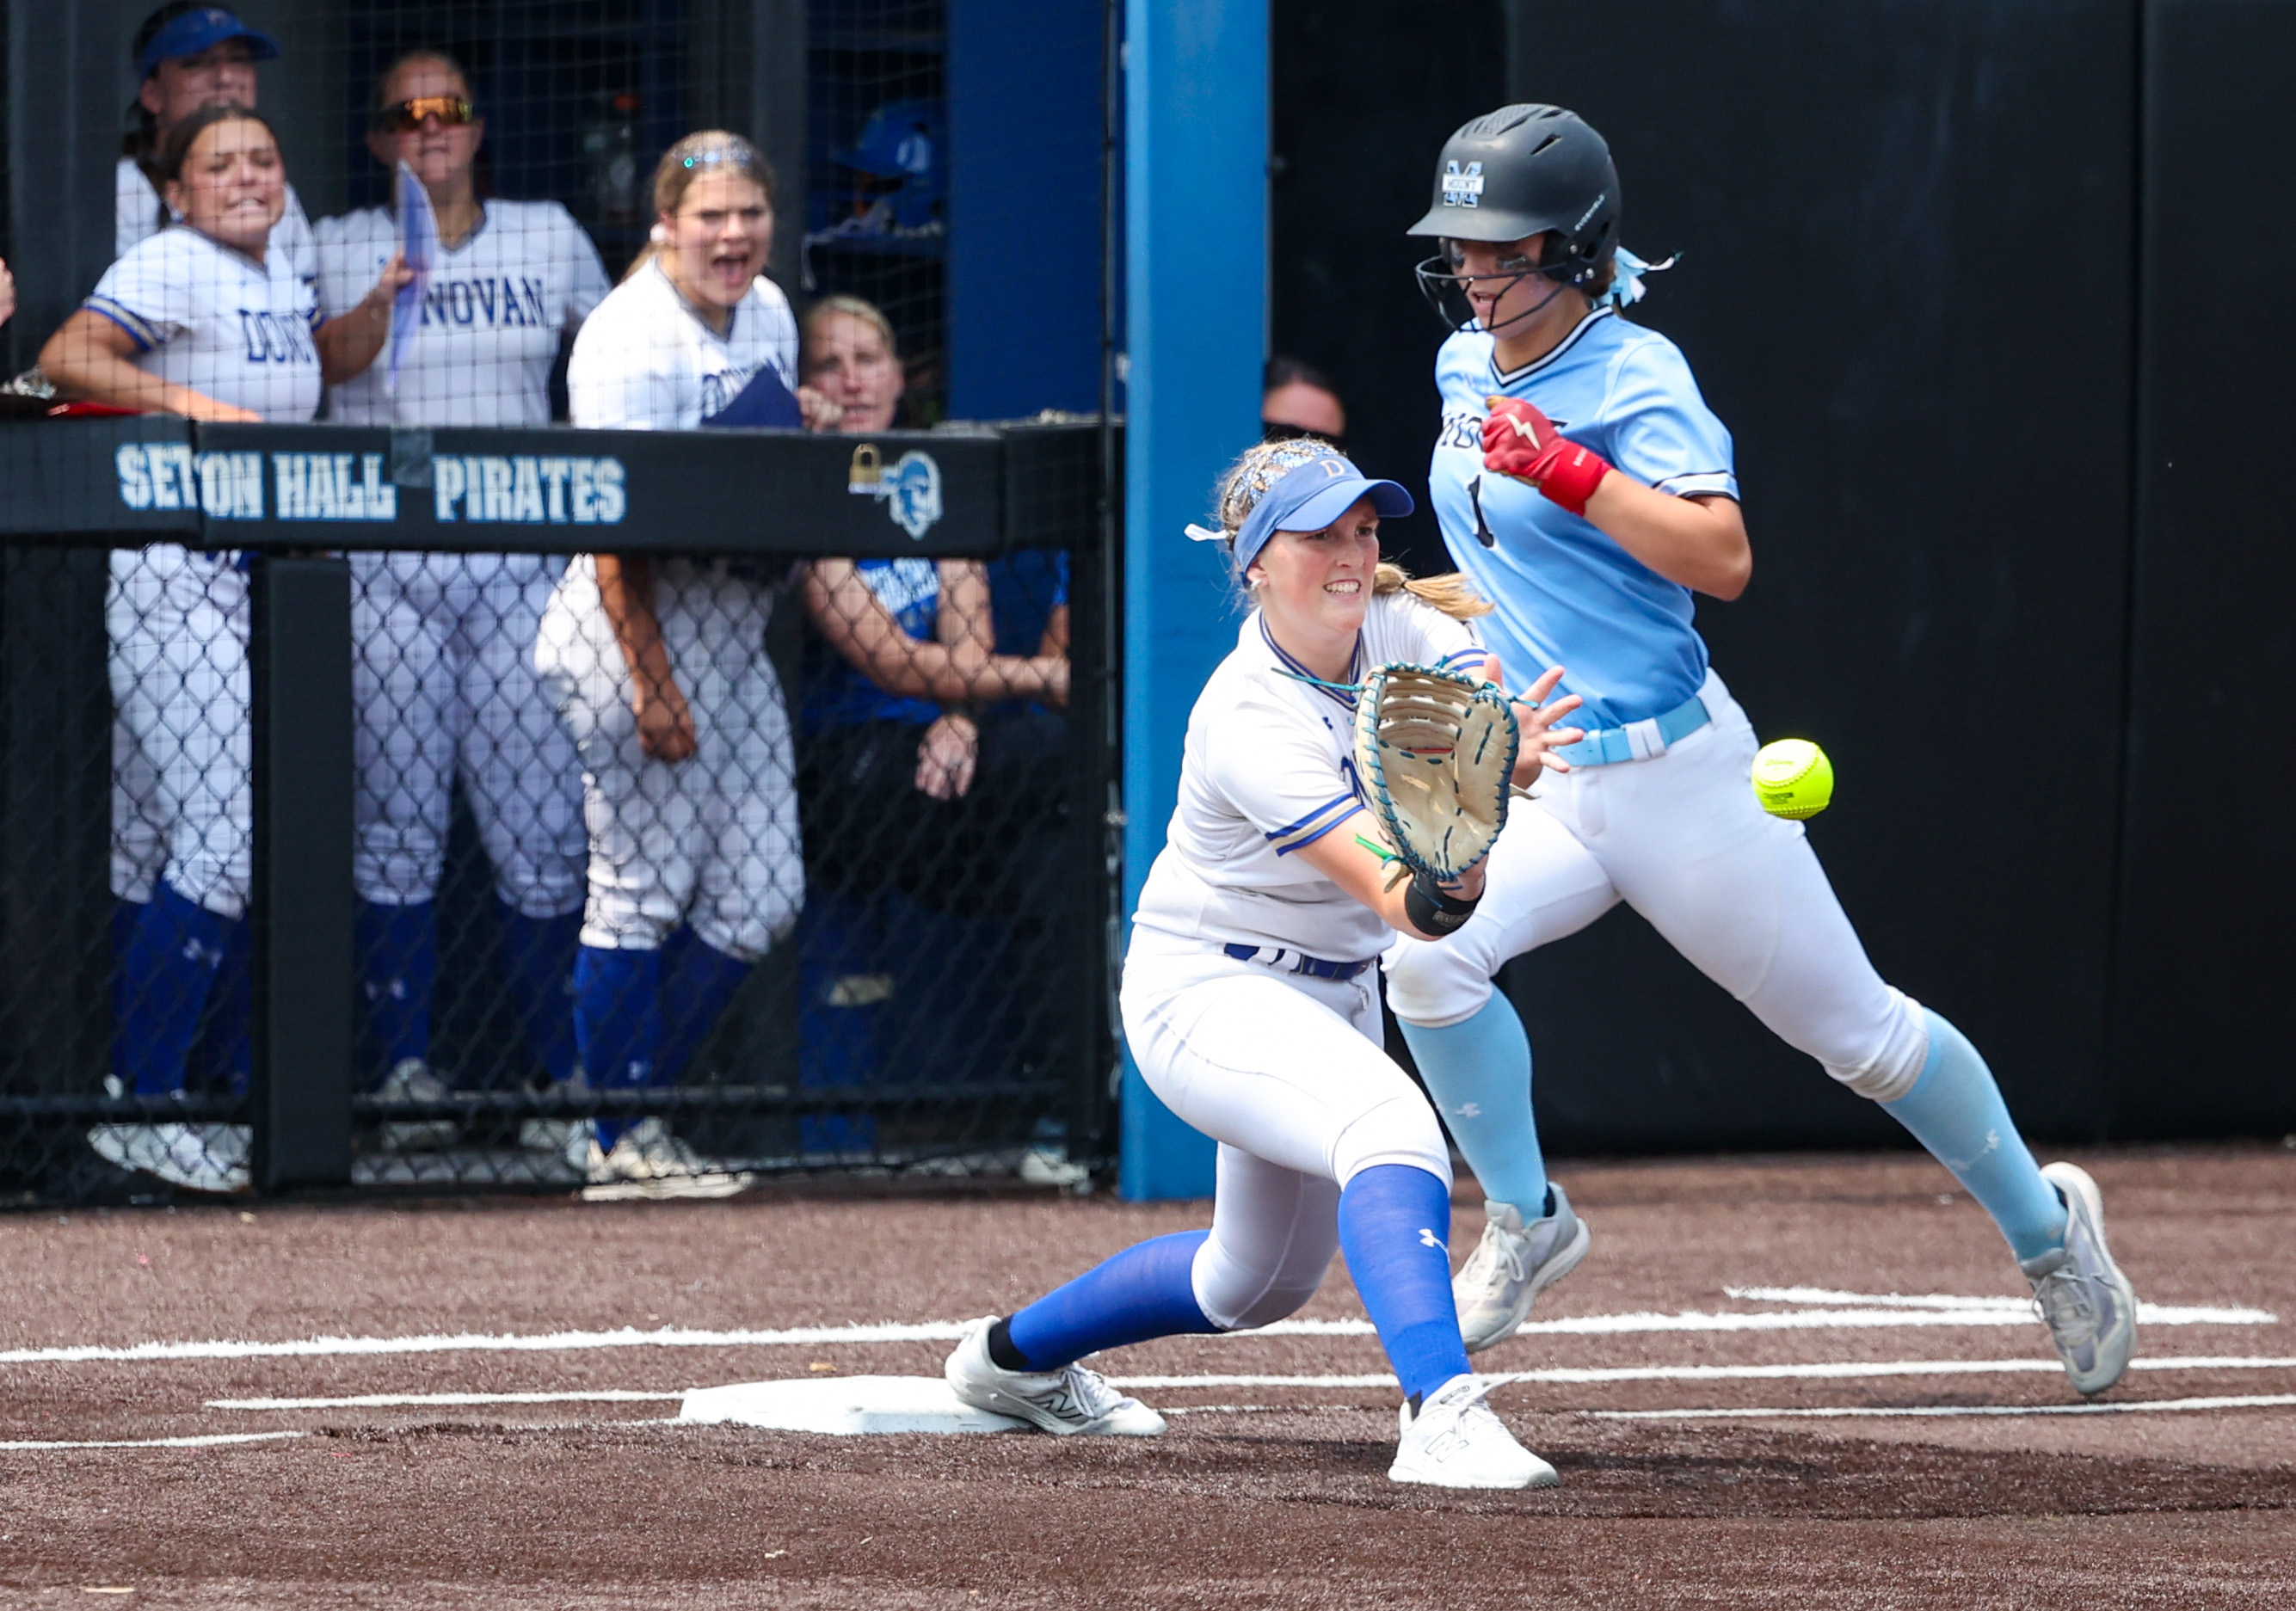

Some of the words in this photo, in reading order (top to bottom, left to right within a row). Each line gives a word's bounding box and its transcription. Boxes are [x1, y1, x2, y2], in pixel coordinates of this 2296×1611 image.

[420, 275, 545, 327] NOVAN
[116, 441, 264, 521] SETON
[271, 452, 397, 522] HALL
[432, 456, 628, 524] PIRATES
[1318, 459, 1345, 477] D
[1465, 472, 1498, 550] 1
